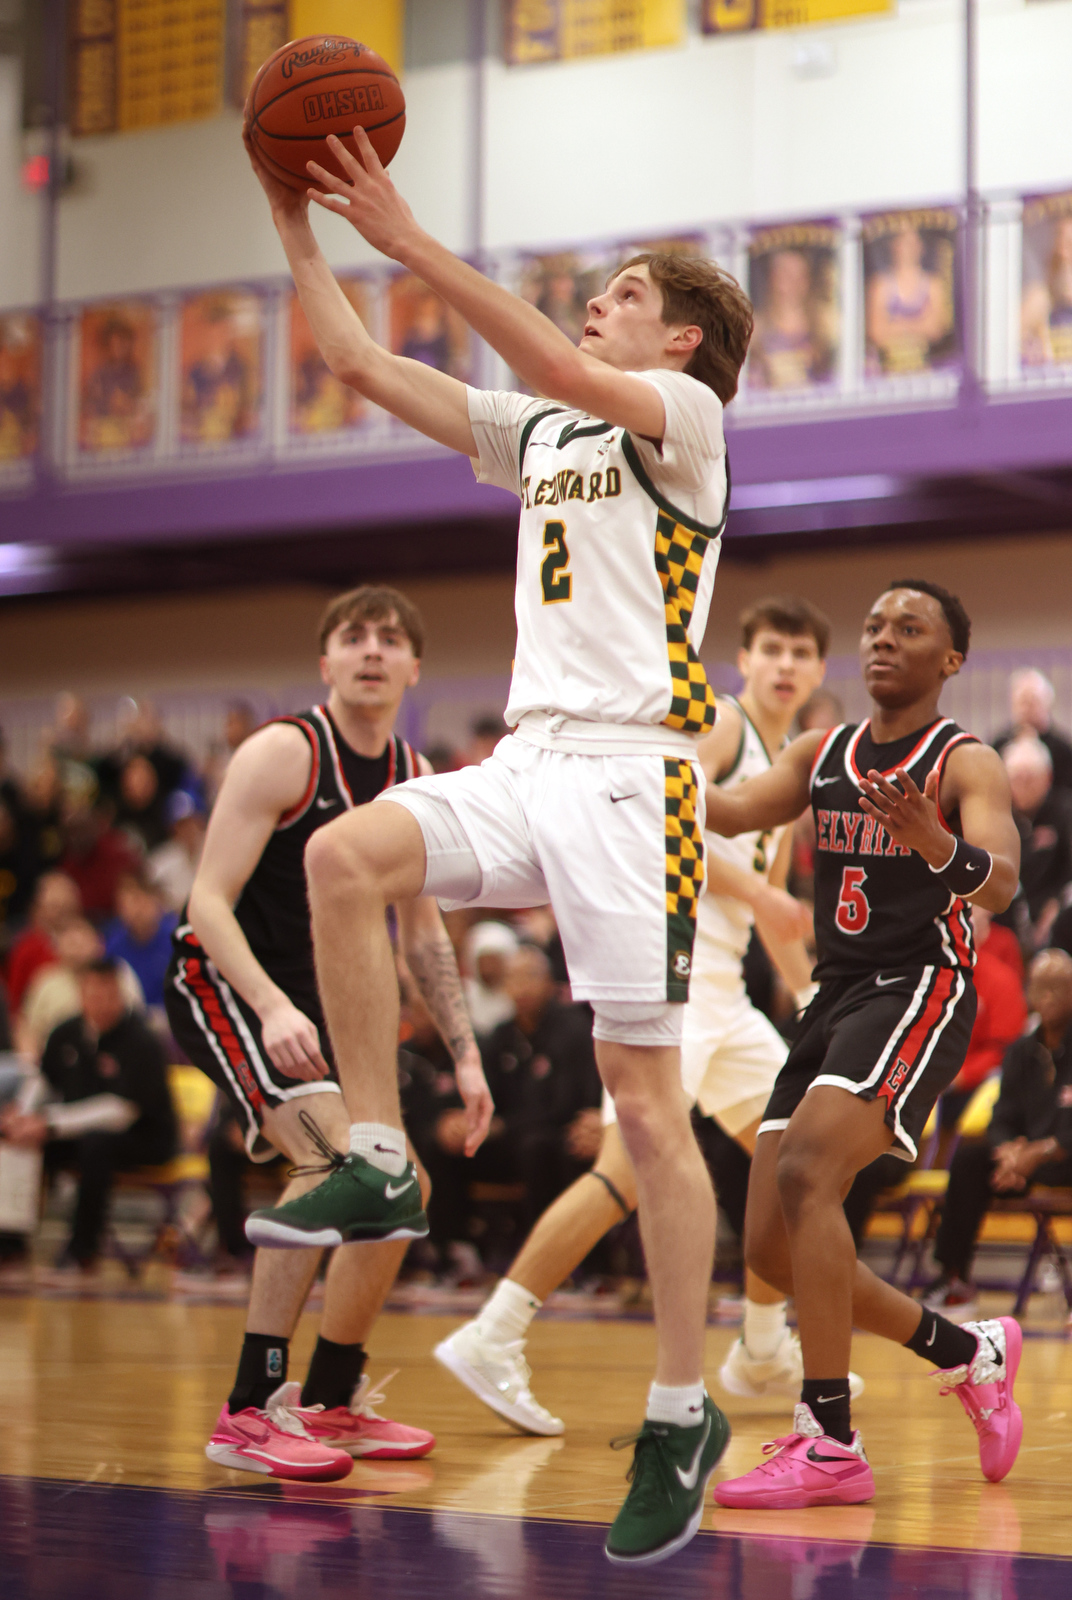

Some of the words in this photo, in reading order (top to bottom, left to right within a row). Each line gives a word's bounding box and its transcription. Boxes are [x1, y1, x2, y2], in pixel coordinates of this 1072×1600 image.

[303, 84, 384, 124] OHSAA
[540, 519, 573, 606] 2
[835, 865, 872, 935] 5
